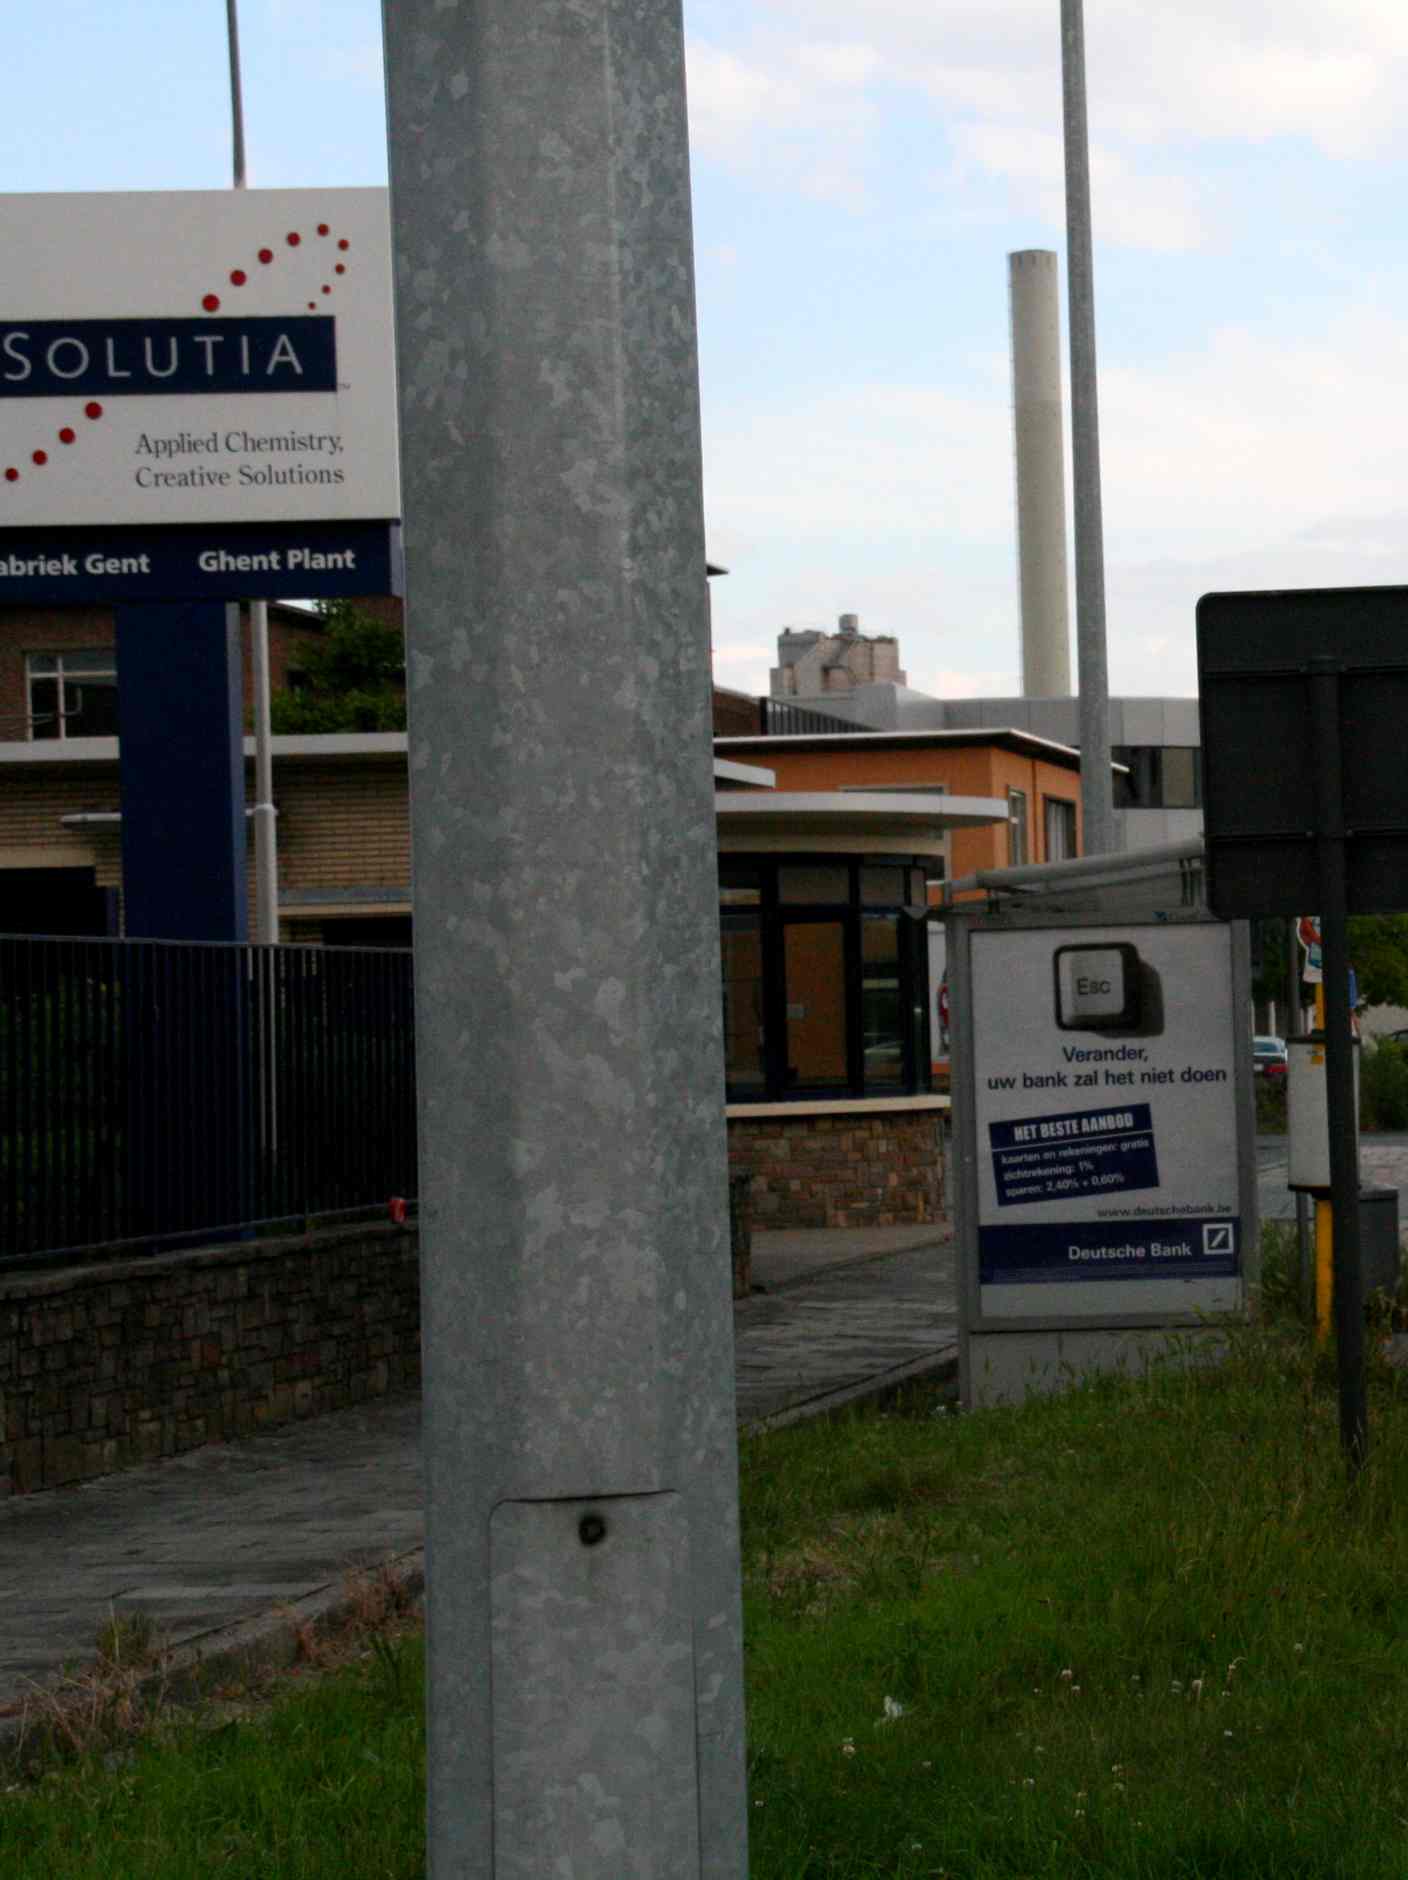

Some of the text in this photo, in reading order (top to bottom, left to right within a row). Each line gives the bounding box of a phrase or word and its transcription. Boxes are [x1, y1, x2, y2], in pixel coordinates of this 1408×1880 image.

[3, 331, 304, 381] SOLUTIA
[135, 431, 344, 459] Applied Chemistry,
[135, 464, 345, 489] Creative Solutions
[84, 553, 151, 575] Gent
[198, 549, 356, 572] Ghent Plant
[1076, 977, 1112, 996] Esc
[1062, 1045, 1149, 1064] Verander,
[988, 1066, 1228, 1091] uw bank zal het niet doen
[1013, 1112, 1135, 1142] HET BESTE AANBOD
[1001, 1152, 1041, 1165] kaarten
[1042, 1151, 1056, 1161] en
[1119, 1137, 1150, 1152] gratis
[1096, 1202, 1233, 1218] www.deutschebank.be
[1068, 1241, 1193, 1261] Deutsche Bank
